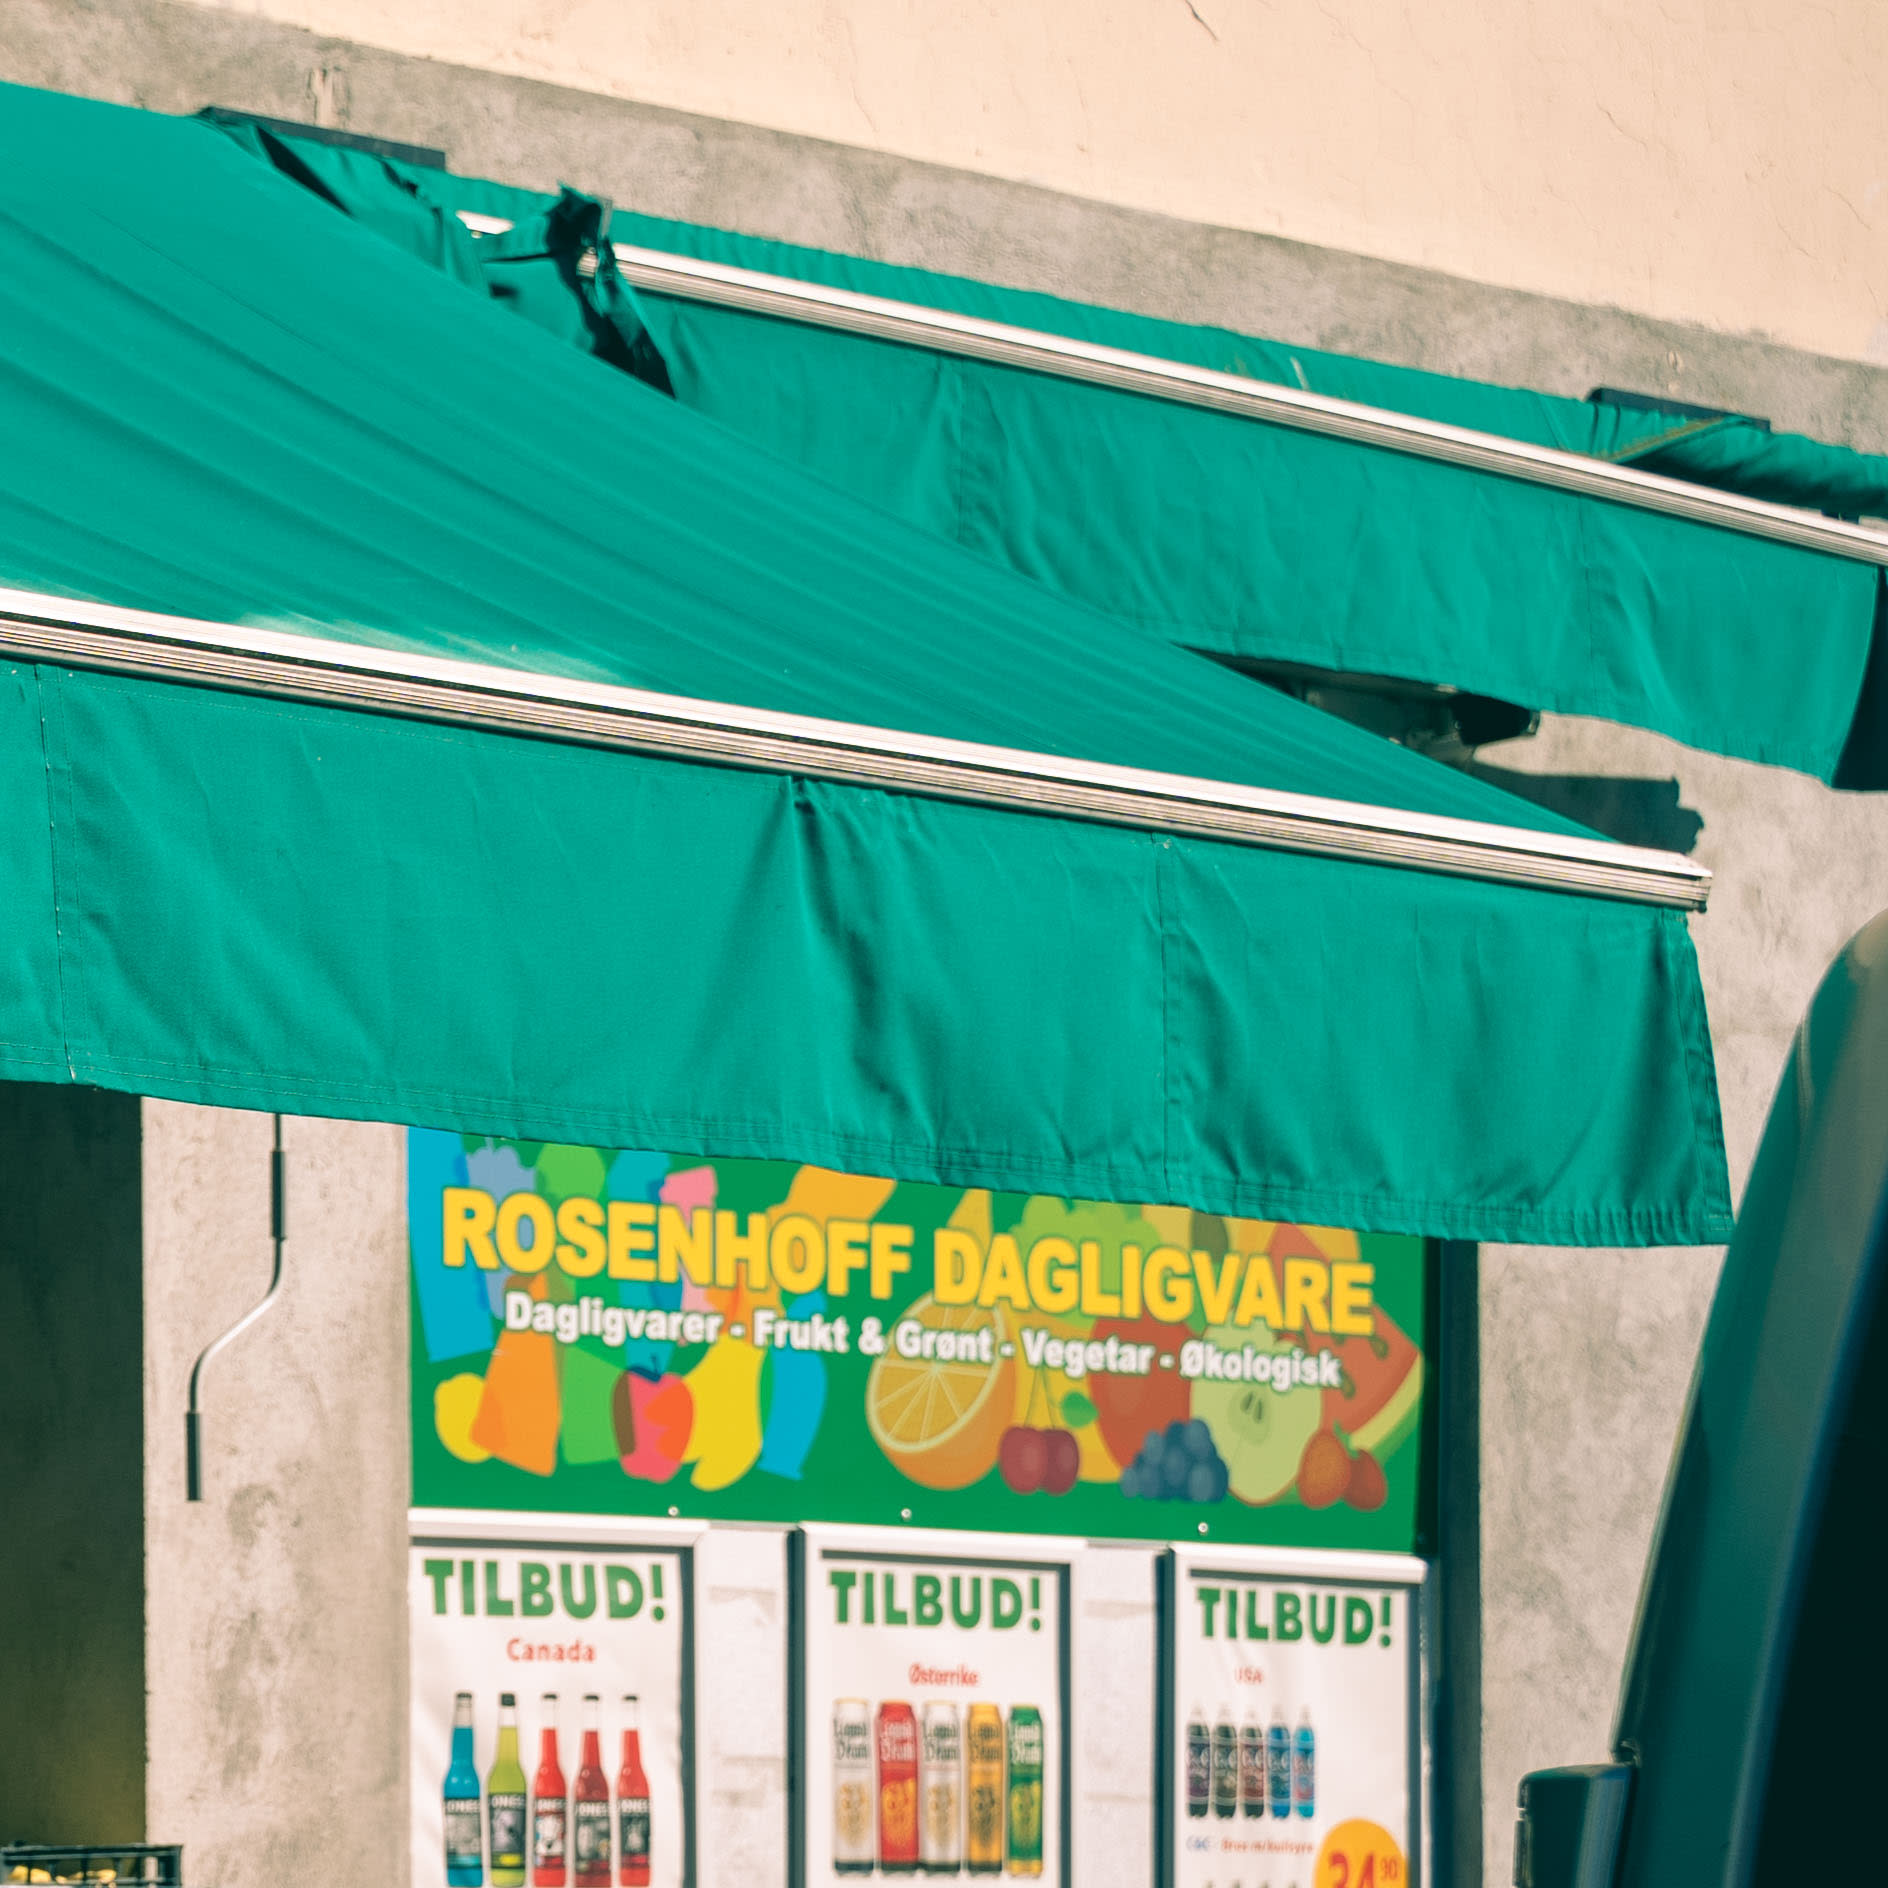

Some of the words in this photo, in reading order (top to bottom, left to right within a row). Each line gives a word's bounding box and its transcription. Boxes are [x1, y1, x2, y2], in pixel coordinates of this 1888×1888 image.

[441, 1185, 914, 1298] ROSENHOFF
[932, 1233, 1376, 1335] DAGLIGVARE
[504, 1291, 723, 1347] Dagligvarer
[752, 1309, 850, 1353] Frukt
[859, 1318, 886, 1352] &
[895, 1322, 995, 1363] Grønt
[1023, 1329, 1155, 1380] Vegetar
[1179, 1341, 1343, 1391] Økologisk
[423, 1558, 667, 1623] TILBUD!
[829, 1568, 1041, 1632] TILBUD!
[1197, 1586, 1393, 1648] TILBUD!
[506, 1636, 597, 1664] Canada
